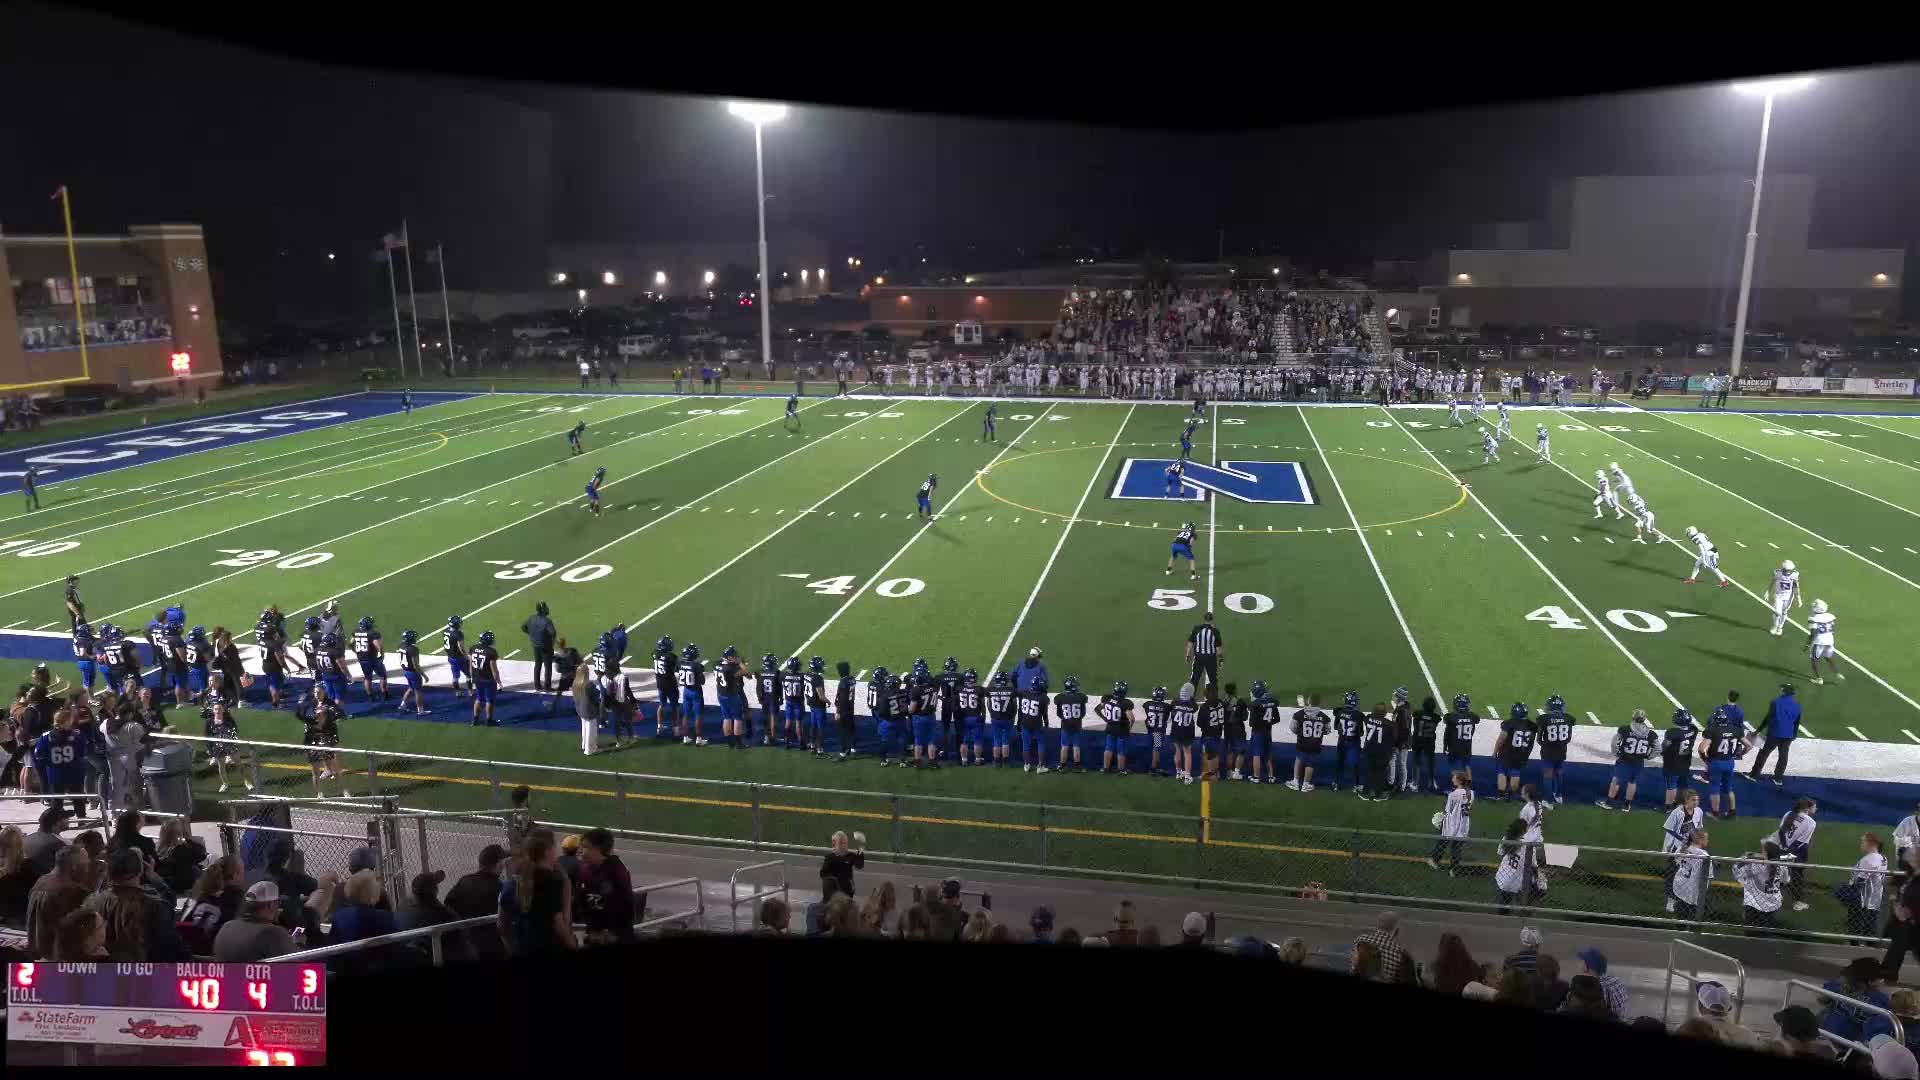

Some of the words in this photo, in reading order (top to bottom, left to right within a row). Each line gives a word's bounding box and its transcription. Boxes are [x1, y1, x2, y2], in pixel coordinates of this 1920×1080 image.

[493, 561, 614, 583] 30
[806, 575, 926, 598] 40
[1147, 588, 1275, 614] 50
[1524, 605, 1668, 633] 40
[471, 654, 486, 669] 57
[592, 656, 606, 672] 35
[960, 693, 978, 709] 56
[991, 695, 1010, 712] 67
[1021, 698, 1039, 716] 85
[1147, 711, 1163, 728] 31
[1173, 710, 1193, 728] 40
[1366, 723, 1383, 744] 71
[1456, 724, 1473, 740] 19
[1547, 724, 1569, 742] 88
[51, 746, 74, 764] 69
[1624, 738, 1648, 755] 36
